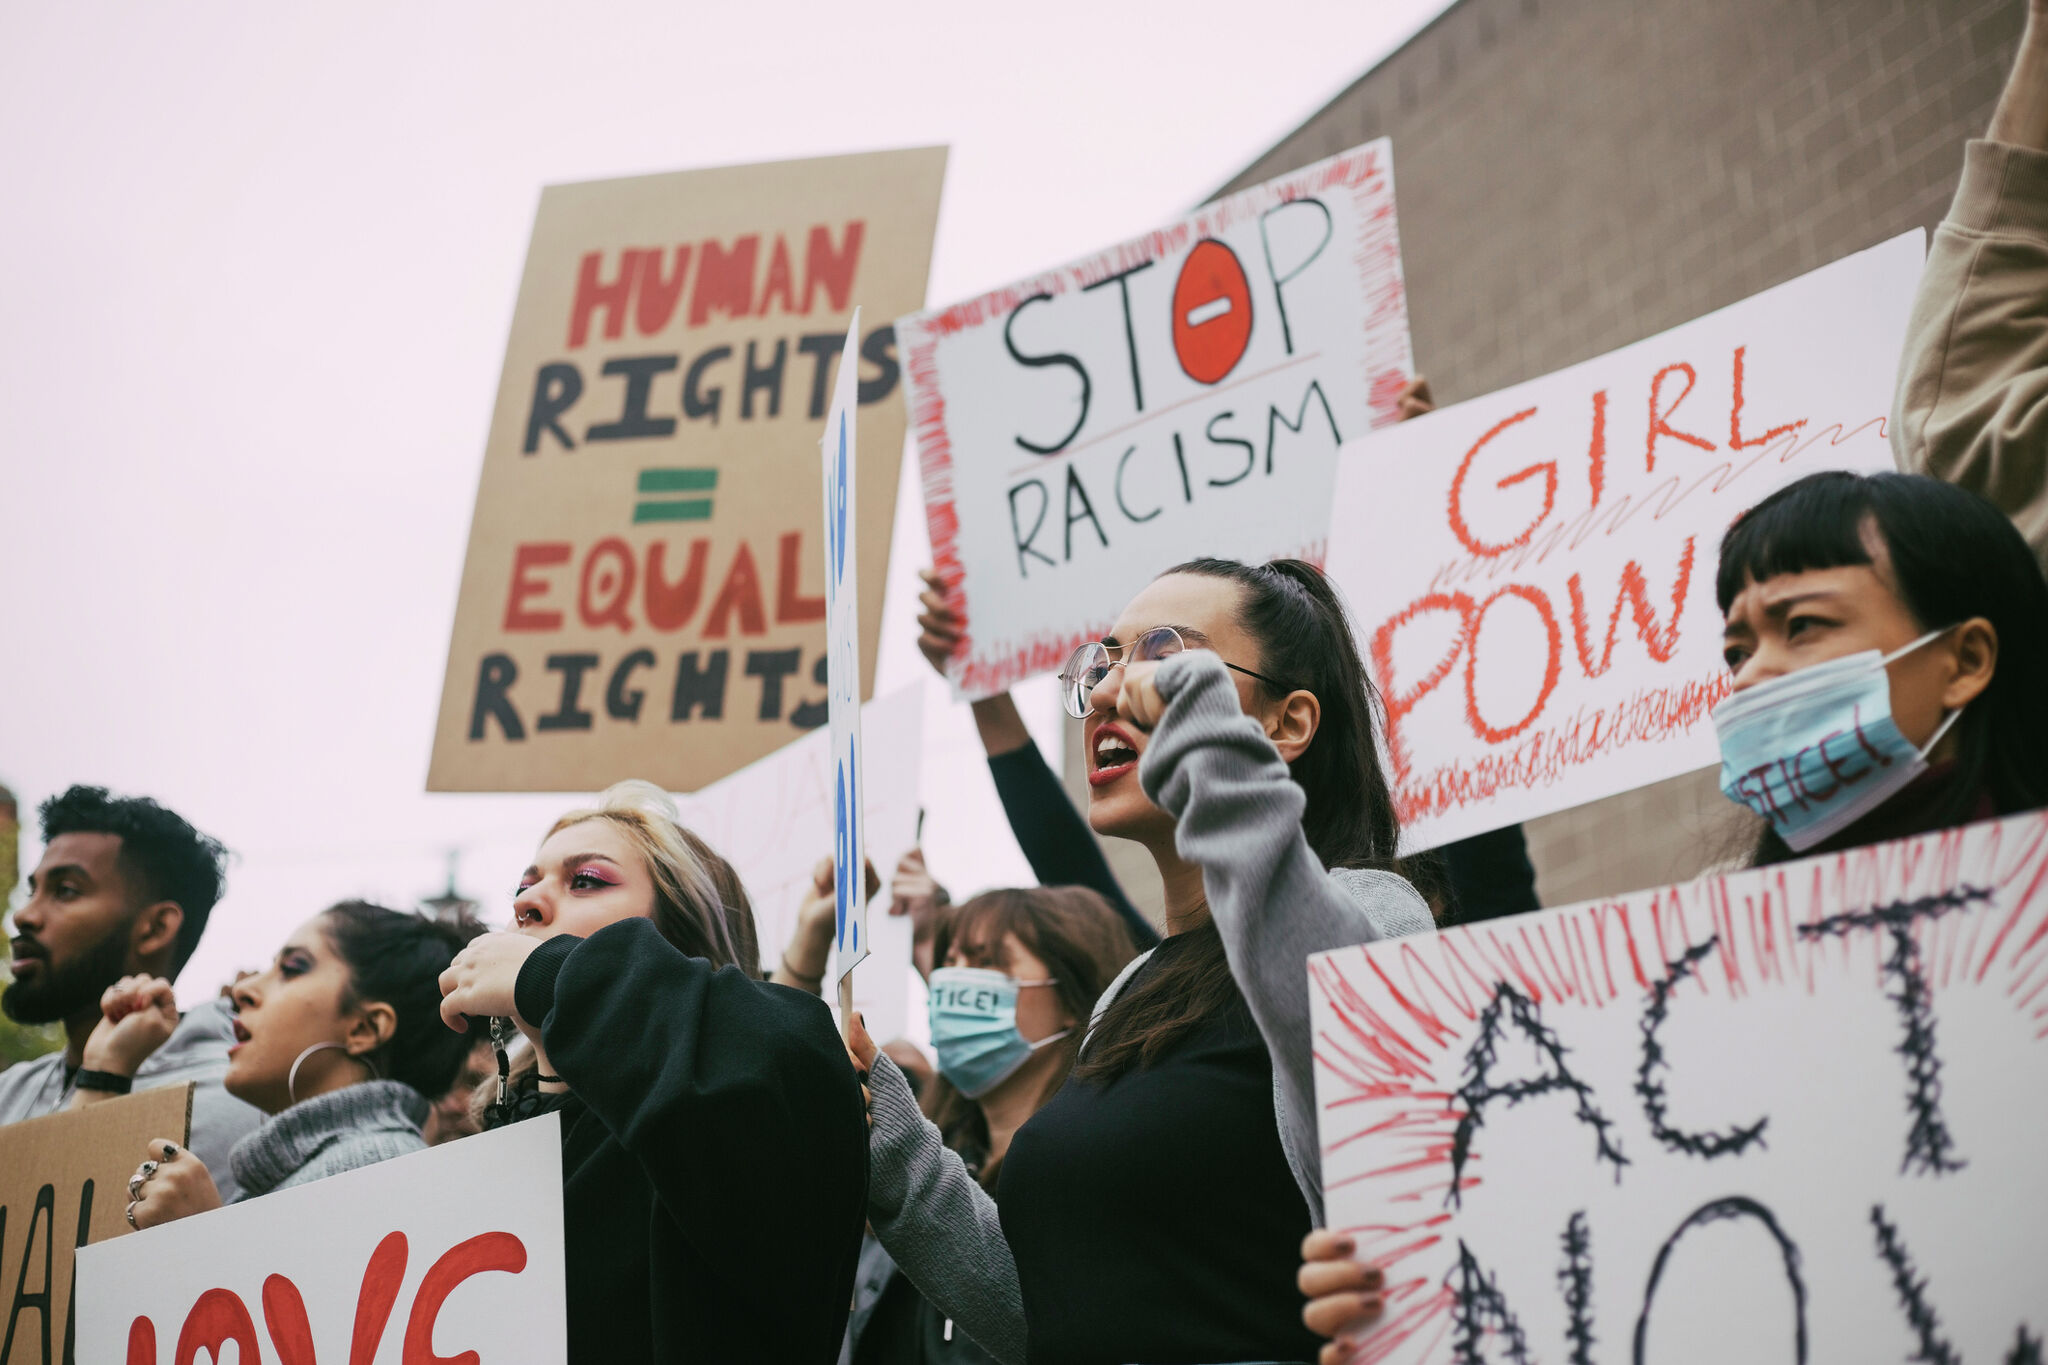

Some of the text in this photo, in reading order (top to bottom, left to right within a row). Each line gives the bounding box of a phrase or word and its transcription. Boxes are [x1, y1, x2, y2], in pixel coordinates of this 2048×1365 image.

[565, 220, 867, 350] HUMAN
[1005, 198, 1332, 456] STOP
[522, 323, 900, 457] RIGHTS
[1448, 346, 1808, 557] GIRL
[1008, 380, 1342, 577] RACISM
[502, 531, 827, 640] EQUAL
[1370, 508, 1752, 788] POW
[1732, 703, 1893, 826] STICE!
[927, 988, 999, 1014] TICE!
[1443, 884, 1998, 1212] ACT
[126, 1230, 528, 1365] VE
